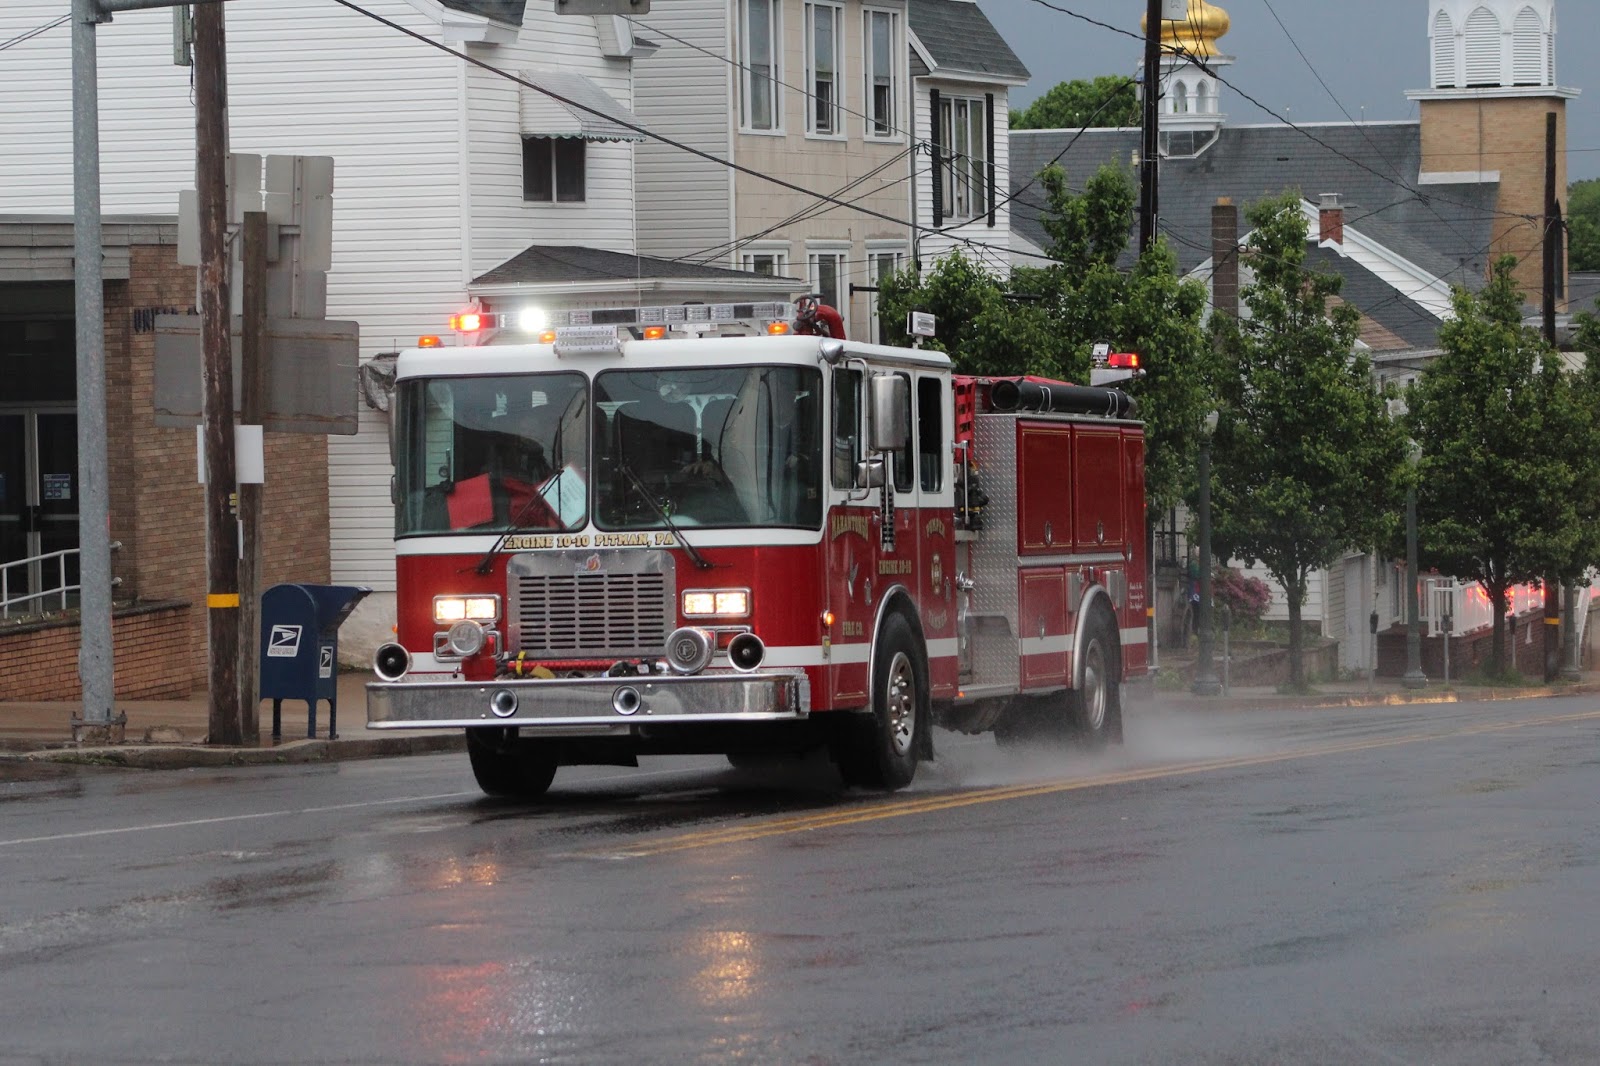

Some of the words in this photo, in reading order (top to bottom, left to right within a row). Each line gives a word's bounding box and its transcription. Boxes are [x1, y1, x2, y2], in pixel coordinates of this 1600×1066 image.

[503, 535, 554, 549] ENGINE
[557, 534, 590, 548] 10-10
[594, 533, 651, 548] PITMAN,
[655, 532, 674, 546] PA
[878, 559, 898, 575] ENGINE
[842, 621, 855, 636] FIRE
